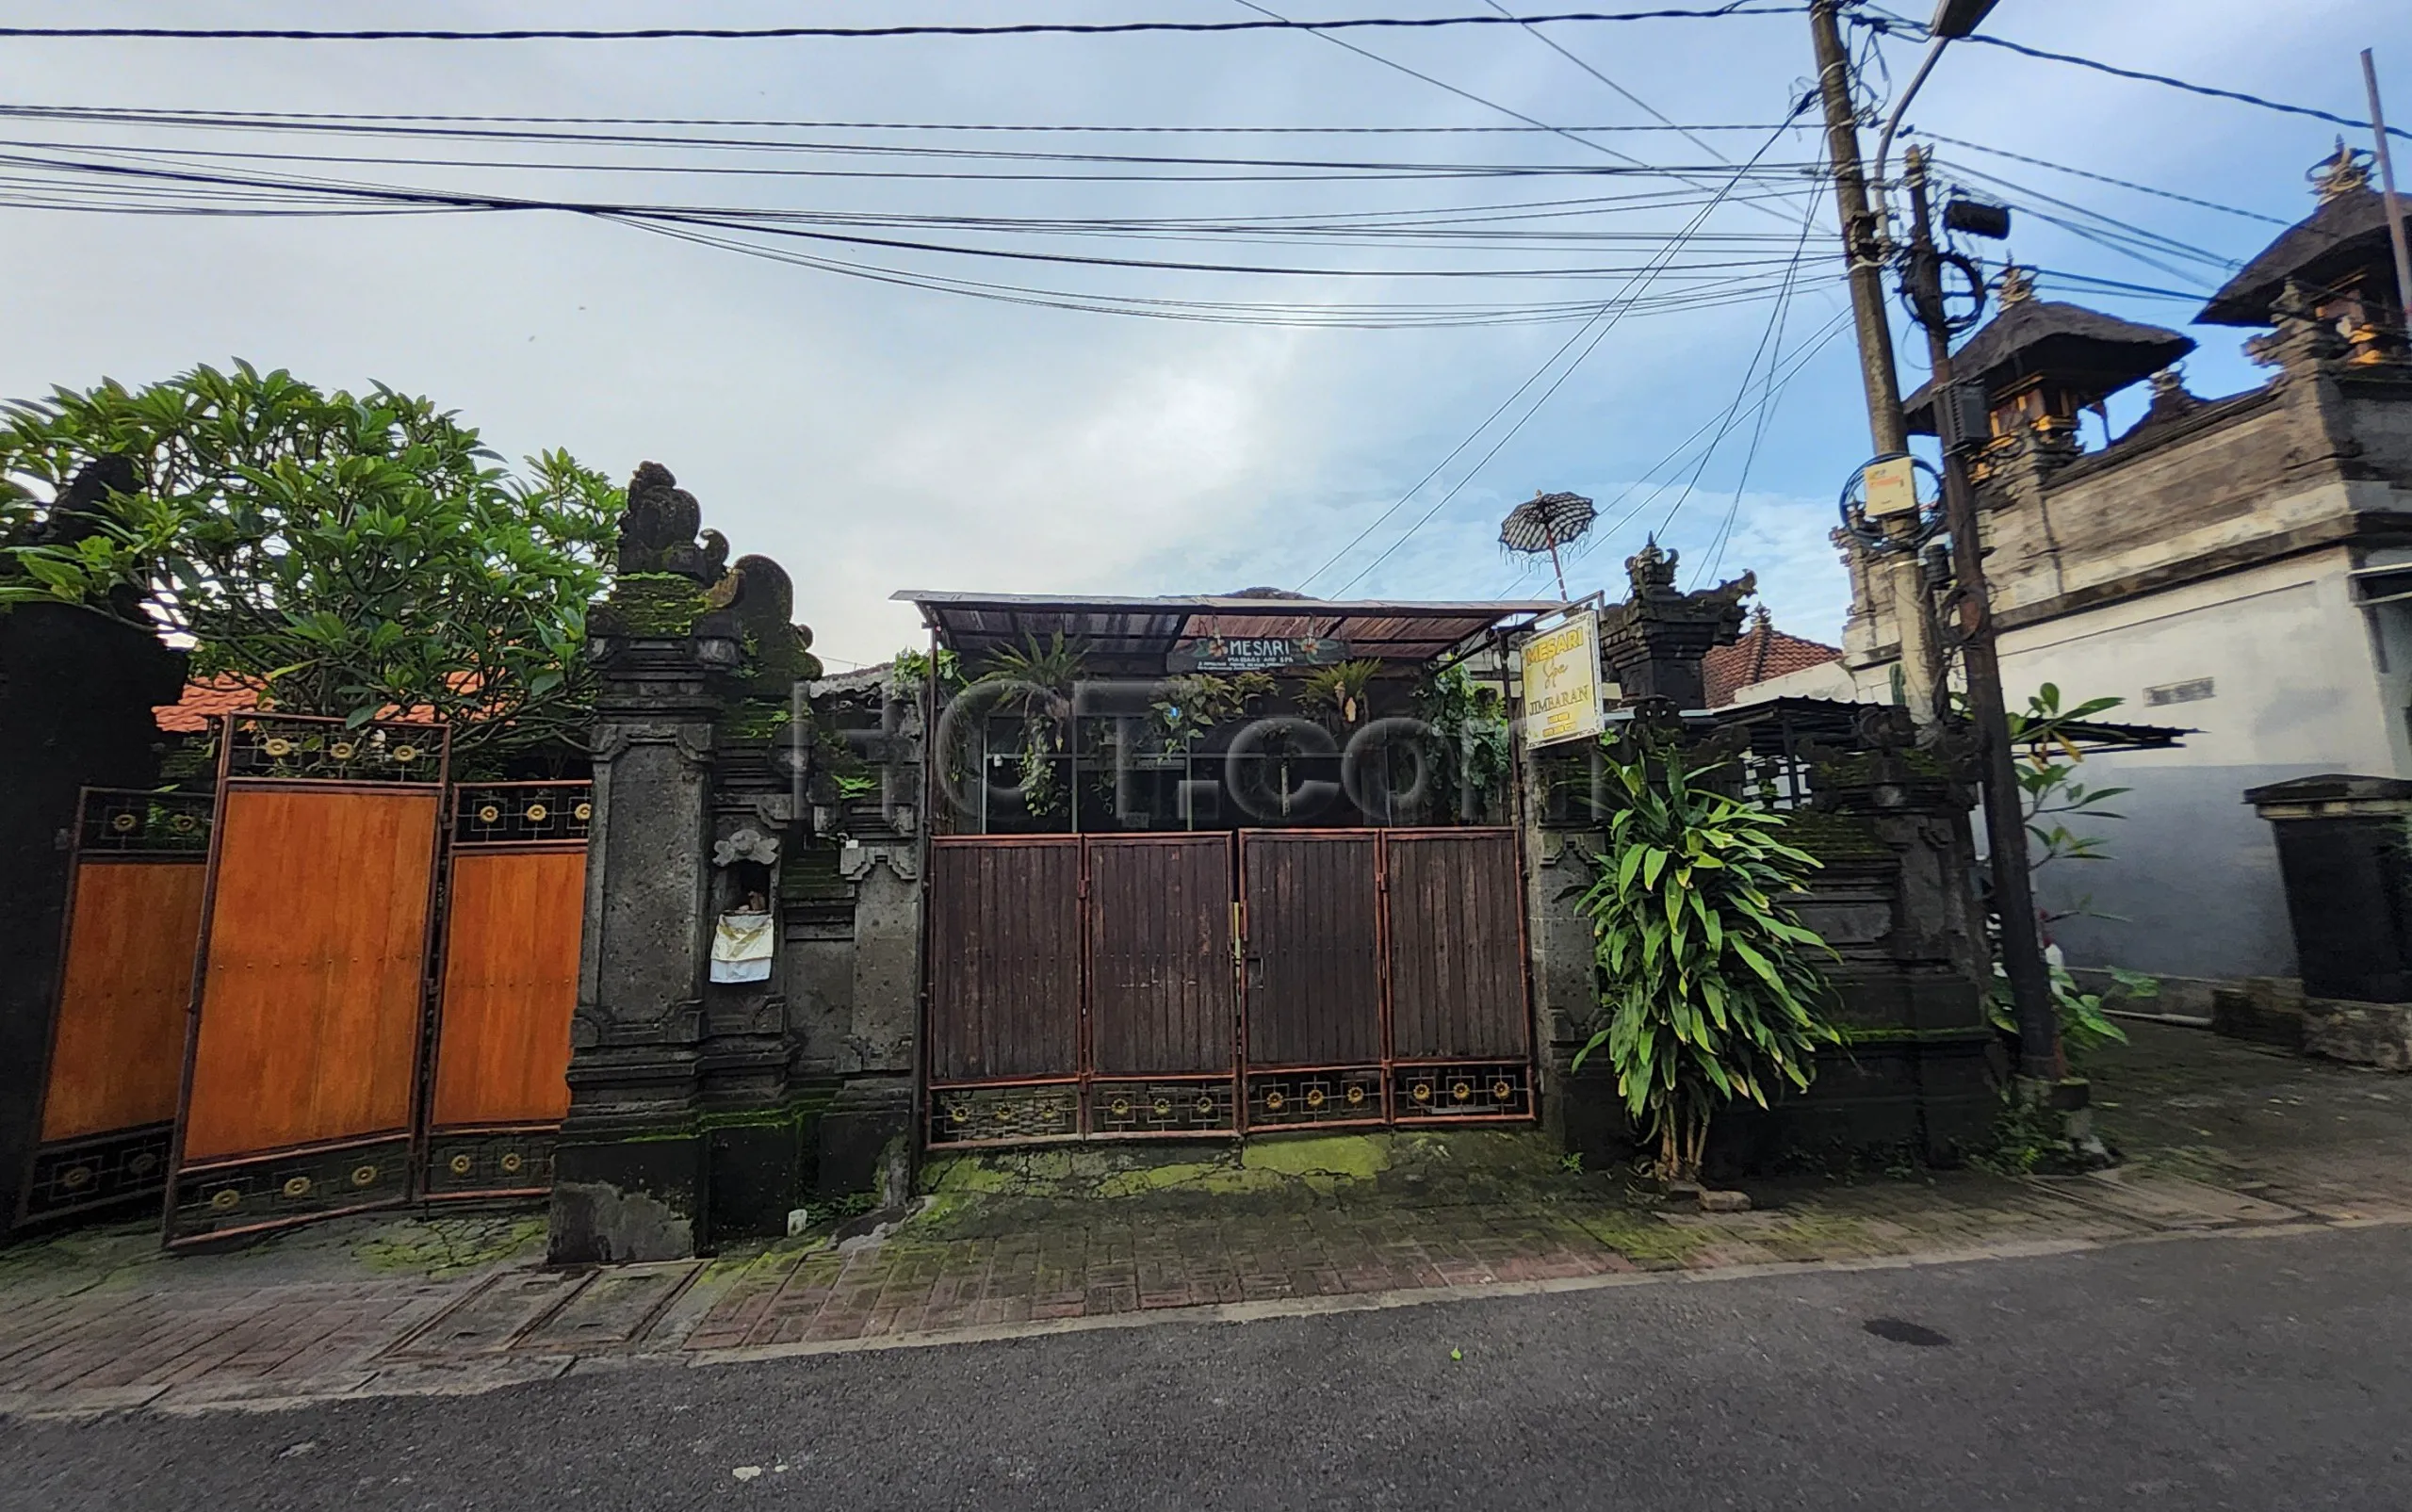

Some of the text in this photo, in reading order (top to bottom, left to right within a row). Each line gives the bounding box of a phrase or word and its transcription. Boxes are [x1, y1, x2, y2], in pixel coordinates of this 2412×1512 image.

[1230, 640, 1290, 657] MESARI
[1525, 626, 1584, 666] MESARI
[1529, 684, 1589, 716] JIMBARAN
